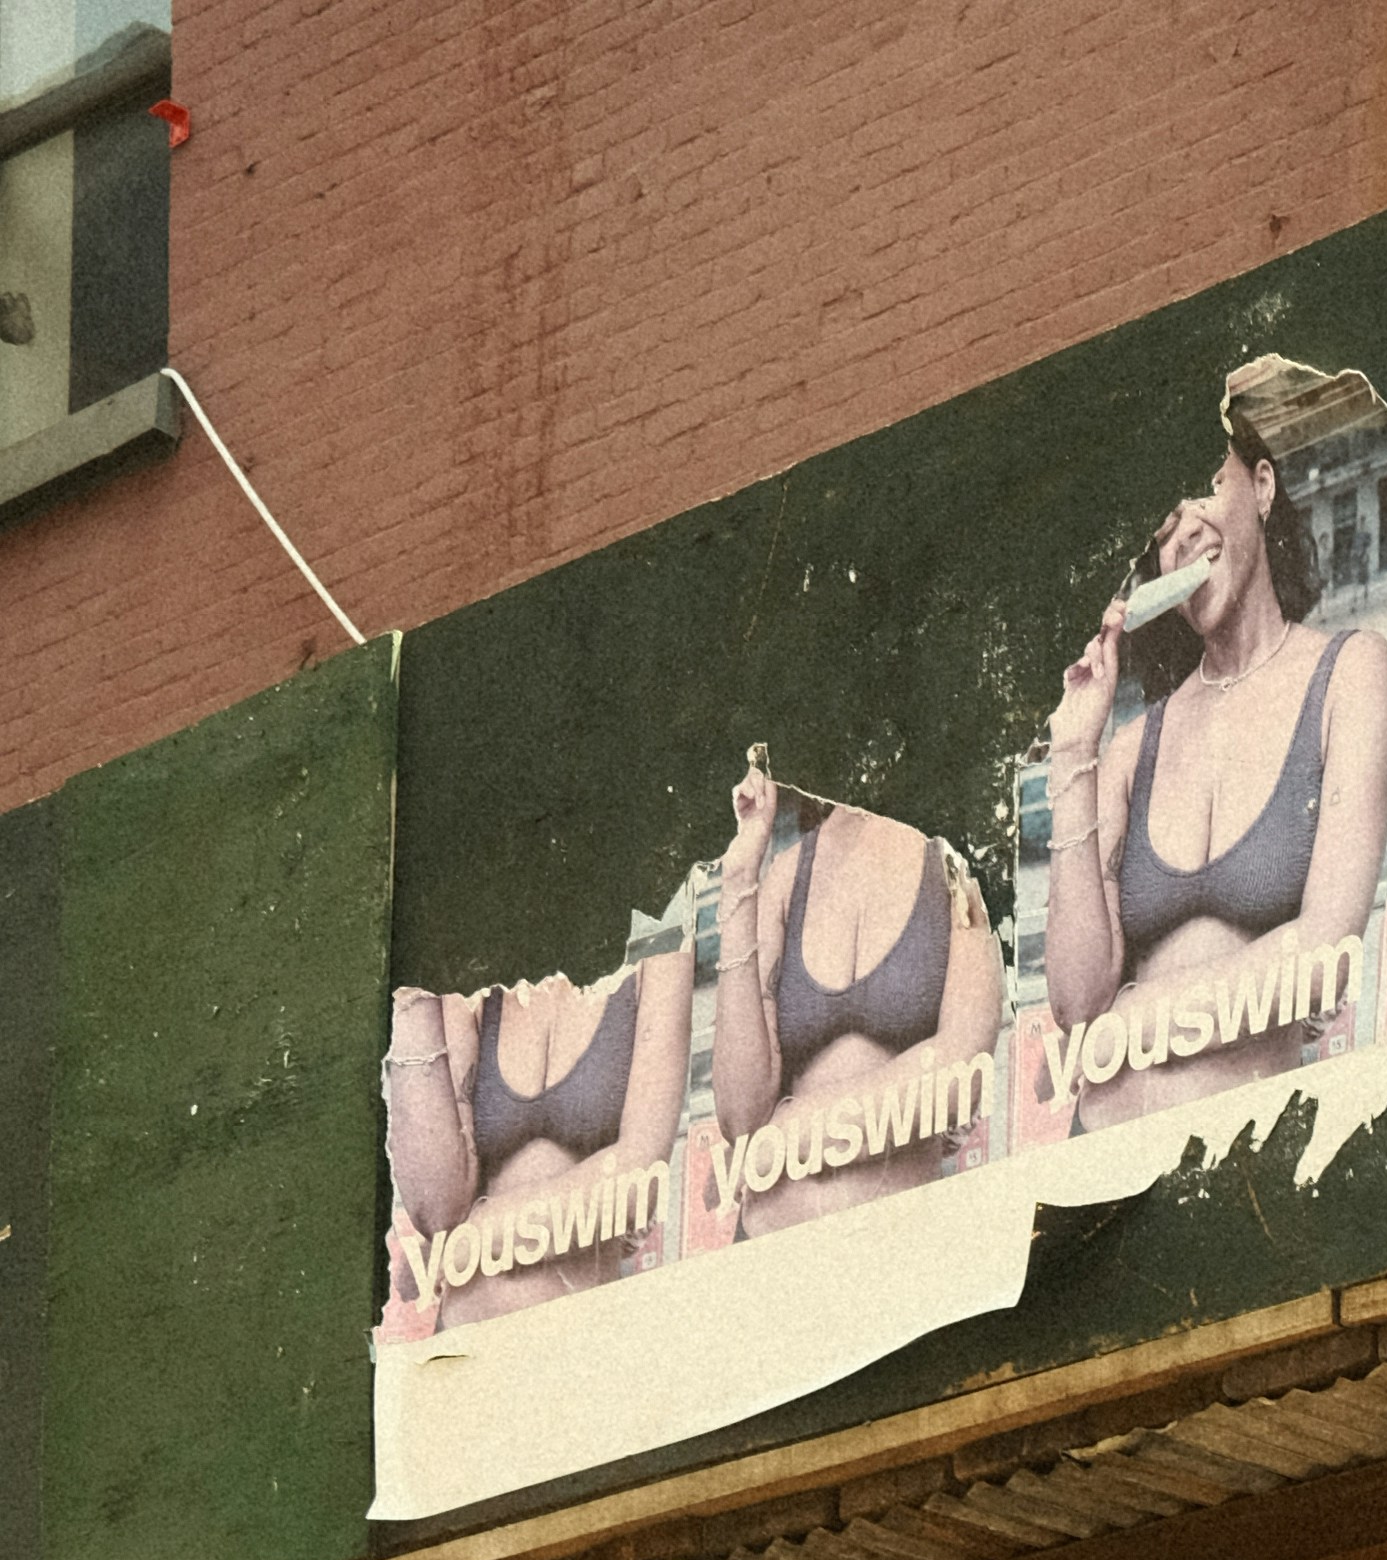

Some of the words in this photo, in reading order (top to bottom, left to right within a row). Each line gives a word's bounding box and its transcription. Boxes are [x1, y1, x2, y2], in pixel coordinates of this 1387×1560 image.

[1041, 929, 1363, 1115] youswim
[710, 1046, 994, 1221] youswim
[401, 1152, 669, 1314] youswim
